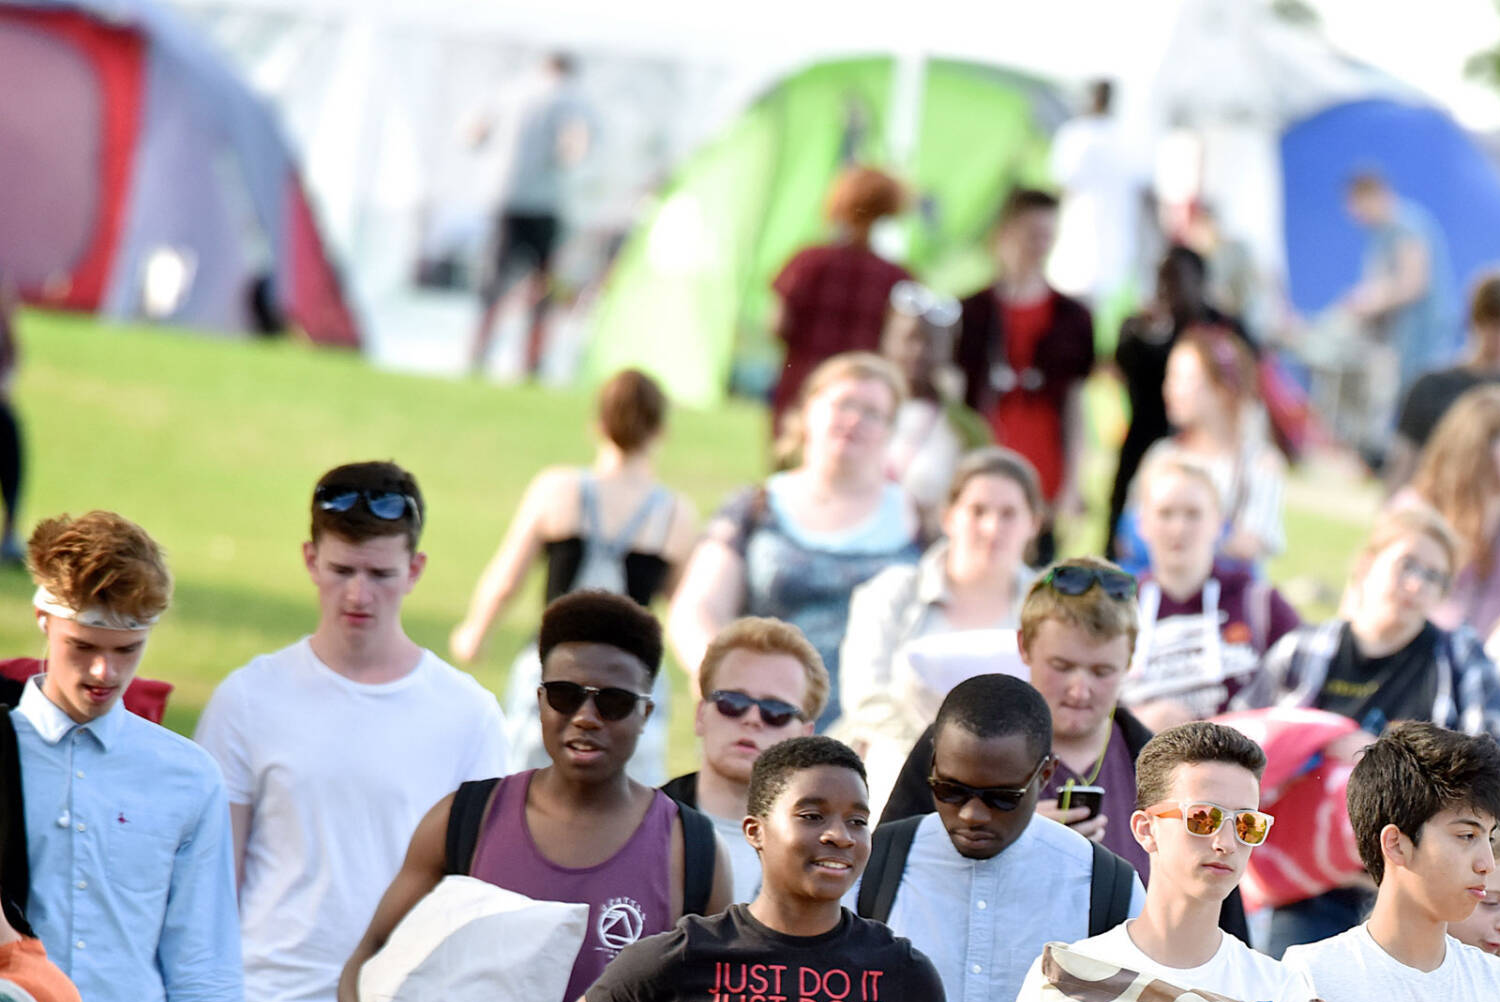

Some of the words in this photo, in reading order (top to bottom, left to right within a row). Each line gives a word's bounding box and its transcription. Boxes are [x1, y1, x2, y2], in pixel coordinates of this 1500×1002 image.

[708, 962, 788, 995] JUST
[799, 966, 851, 1000] DO
[861, 970, 884, 1002] IT
